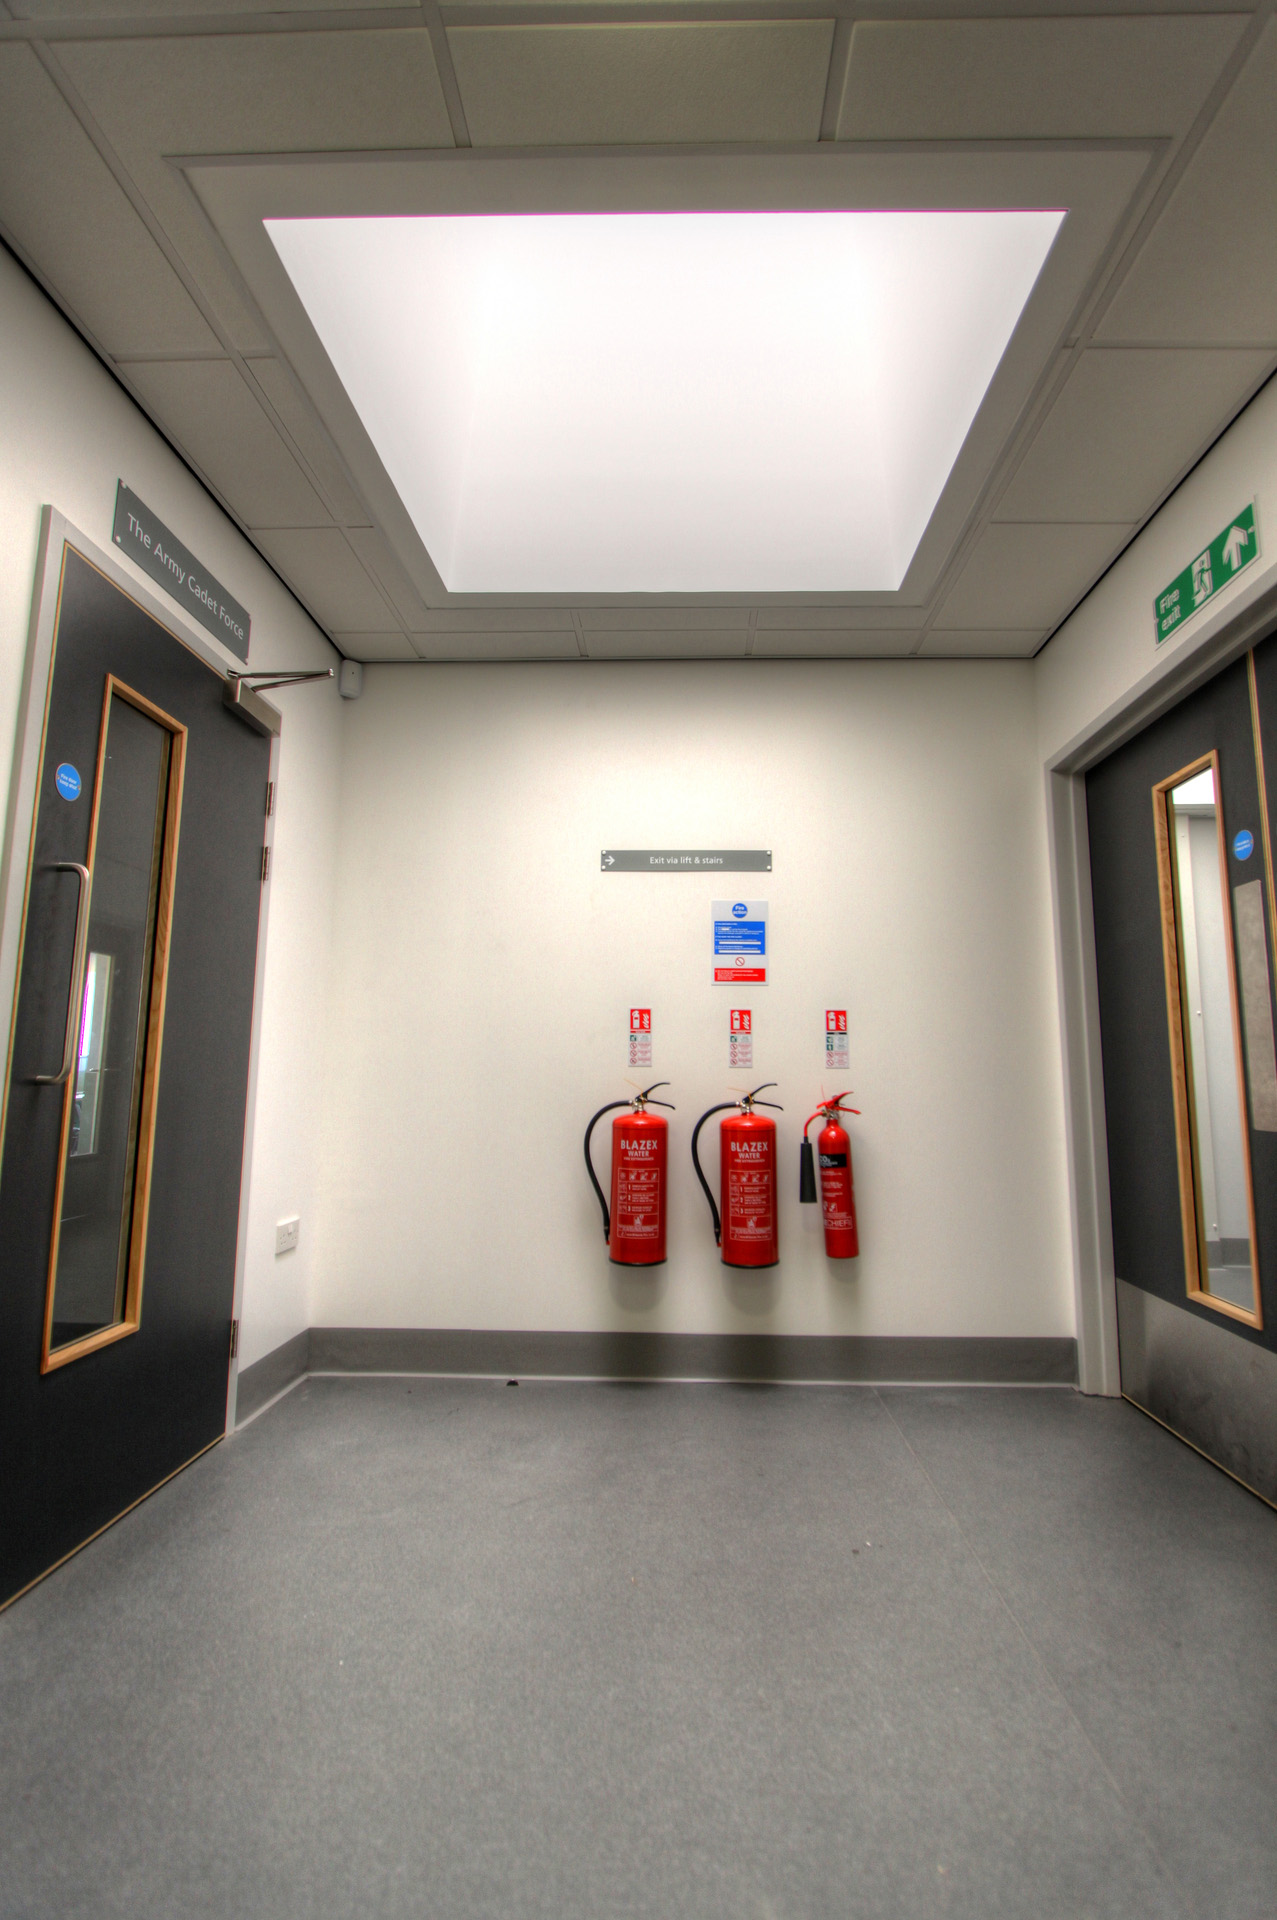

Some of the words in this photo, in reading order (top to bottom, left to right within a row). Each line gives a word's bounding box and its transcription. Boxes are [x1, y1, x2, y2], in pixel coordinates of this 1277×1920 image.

[127, 512, 151, 549] The
[153, 543, 186, 584] Army
[187, 575, 218, 615] Cadet
[219, 605, 244, 640] Force
[1159, 588, 1180, 614] Fire
[1161, 604, 1182, 631] exit
[649, 856, 665, 864] Exit
[666, 856, 679, 864] via
[680, 855, 692, 864] lift
[694, 856, 700, 864] &
[702, 856, 724, 864] stairs
[620, 1139, 658, 1150] BLAZEX
[730, 1141, 768, 1152] BLAZEX
